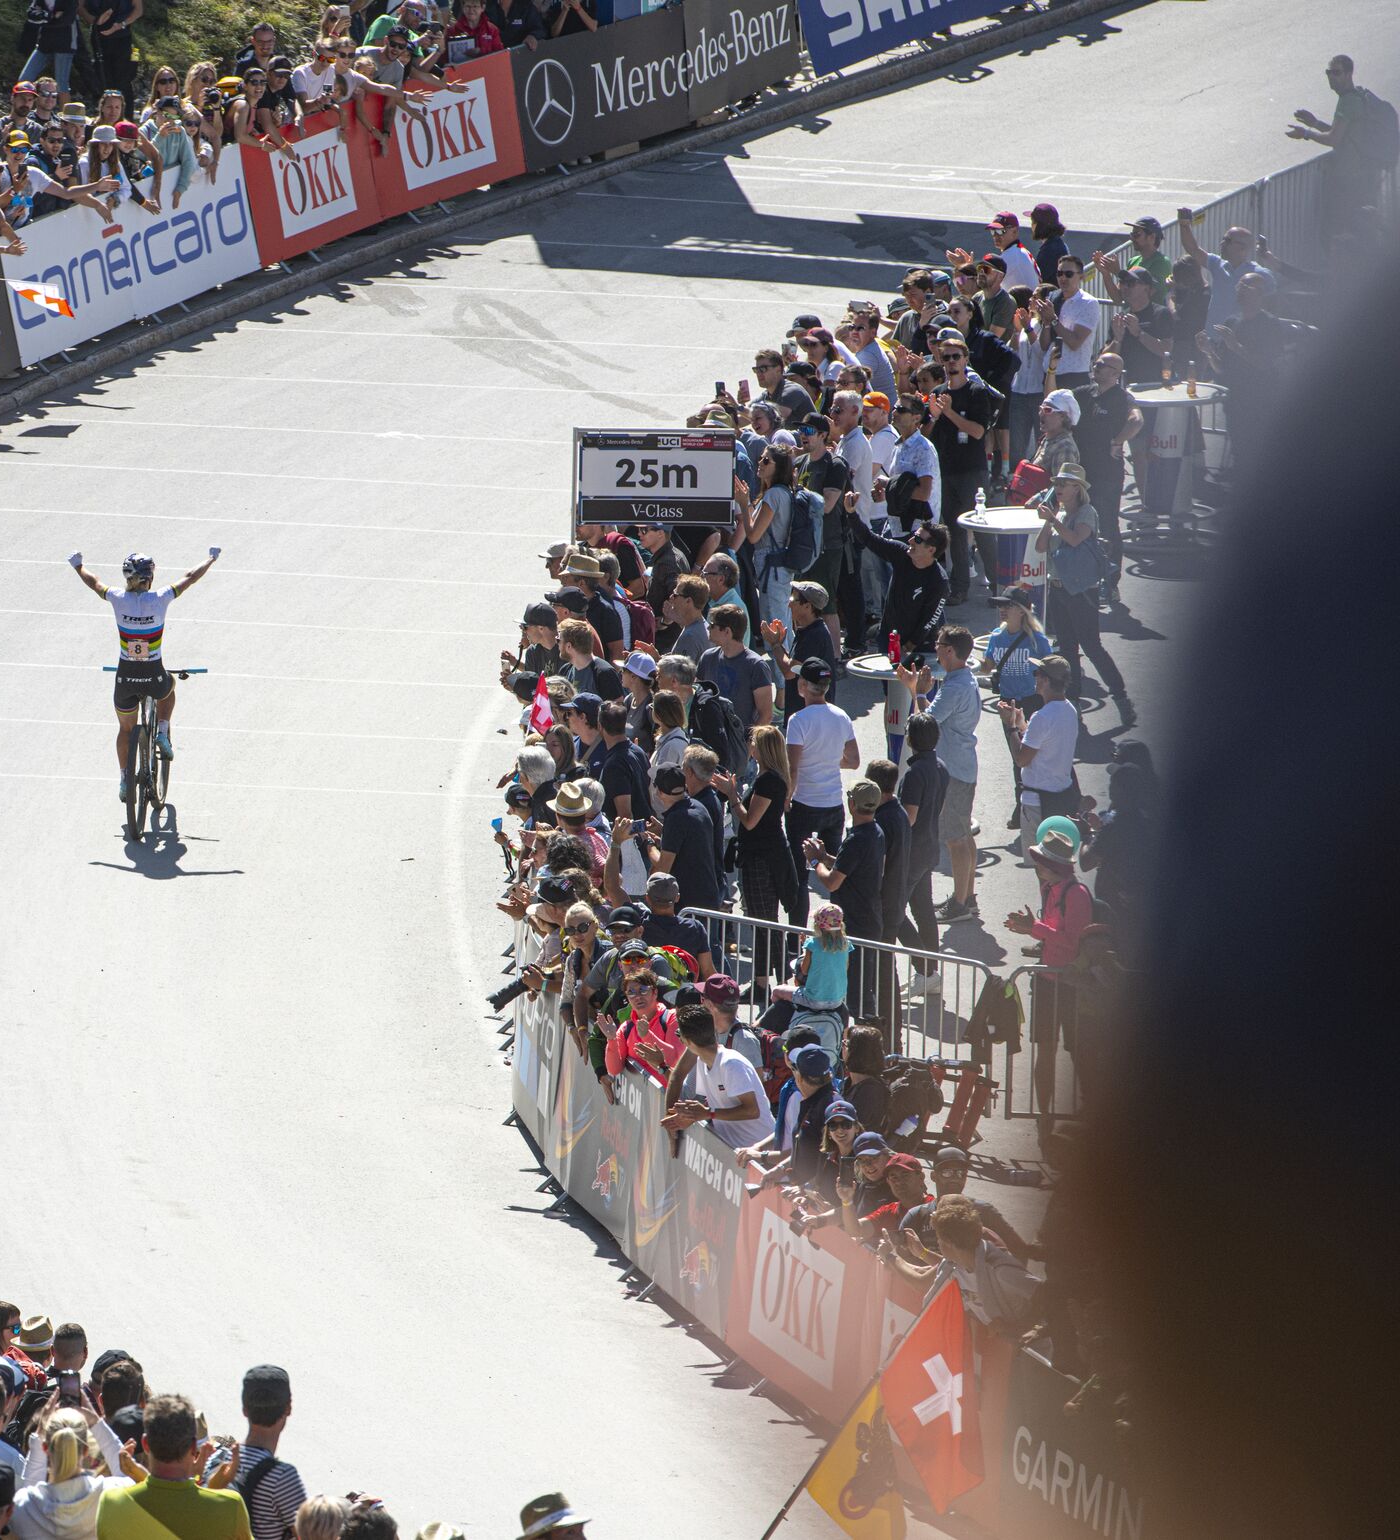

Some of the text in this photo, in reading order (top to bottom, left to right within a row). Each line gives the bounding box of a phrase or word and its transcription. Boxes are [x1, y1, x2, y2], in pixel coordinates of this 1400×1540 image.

[591, 4, 791, 118] Mercedes-Benz
[401, 97, 486, 168] ÖKK
[278, 144, 347, 216] ÖKK
[799, 167, 846, 178] 2
[910, 170, 955, 181] 3
[661, 438, 680, 446] UCI
[616, 459, 697, 488] 25m
[631, 504, 683, 518] V-Class
[1021, 561, 1045, 577] Bull
[135, 645, 141, 654] 8
[628, 1083, 642, 1120] ON
[684, 1135, 743, 1207] WATCH ON
[760, 1224, 834, 1360] ÖKK
[1013, 1426, 1144, 1540] GARMIN
